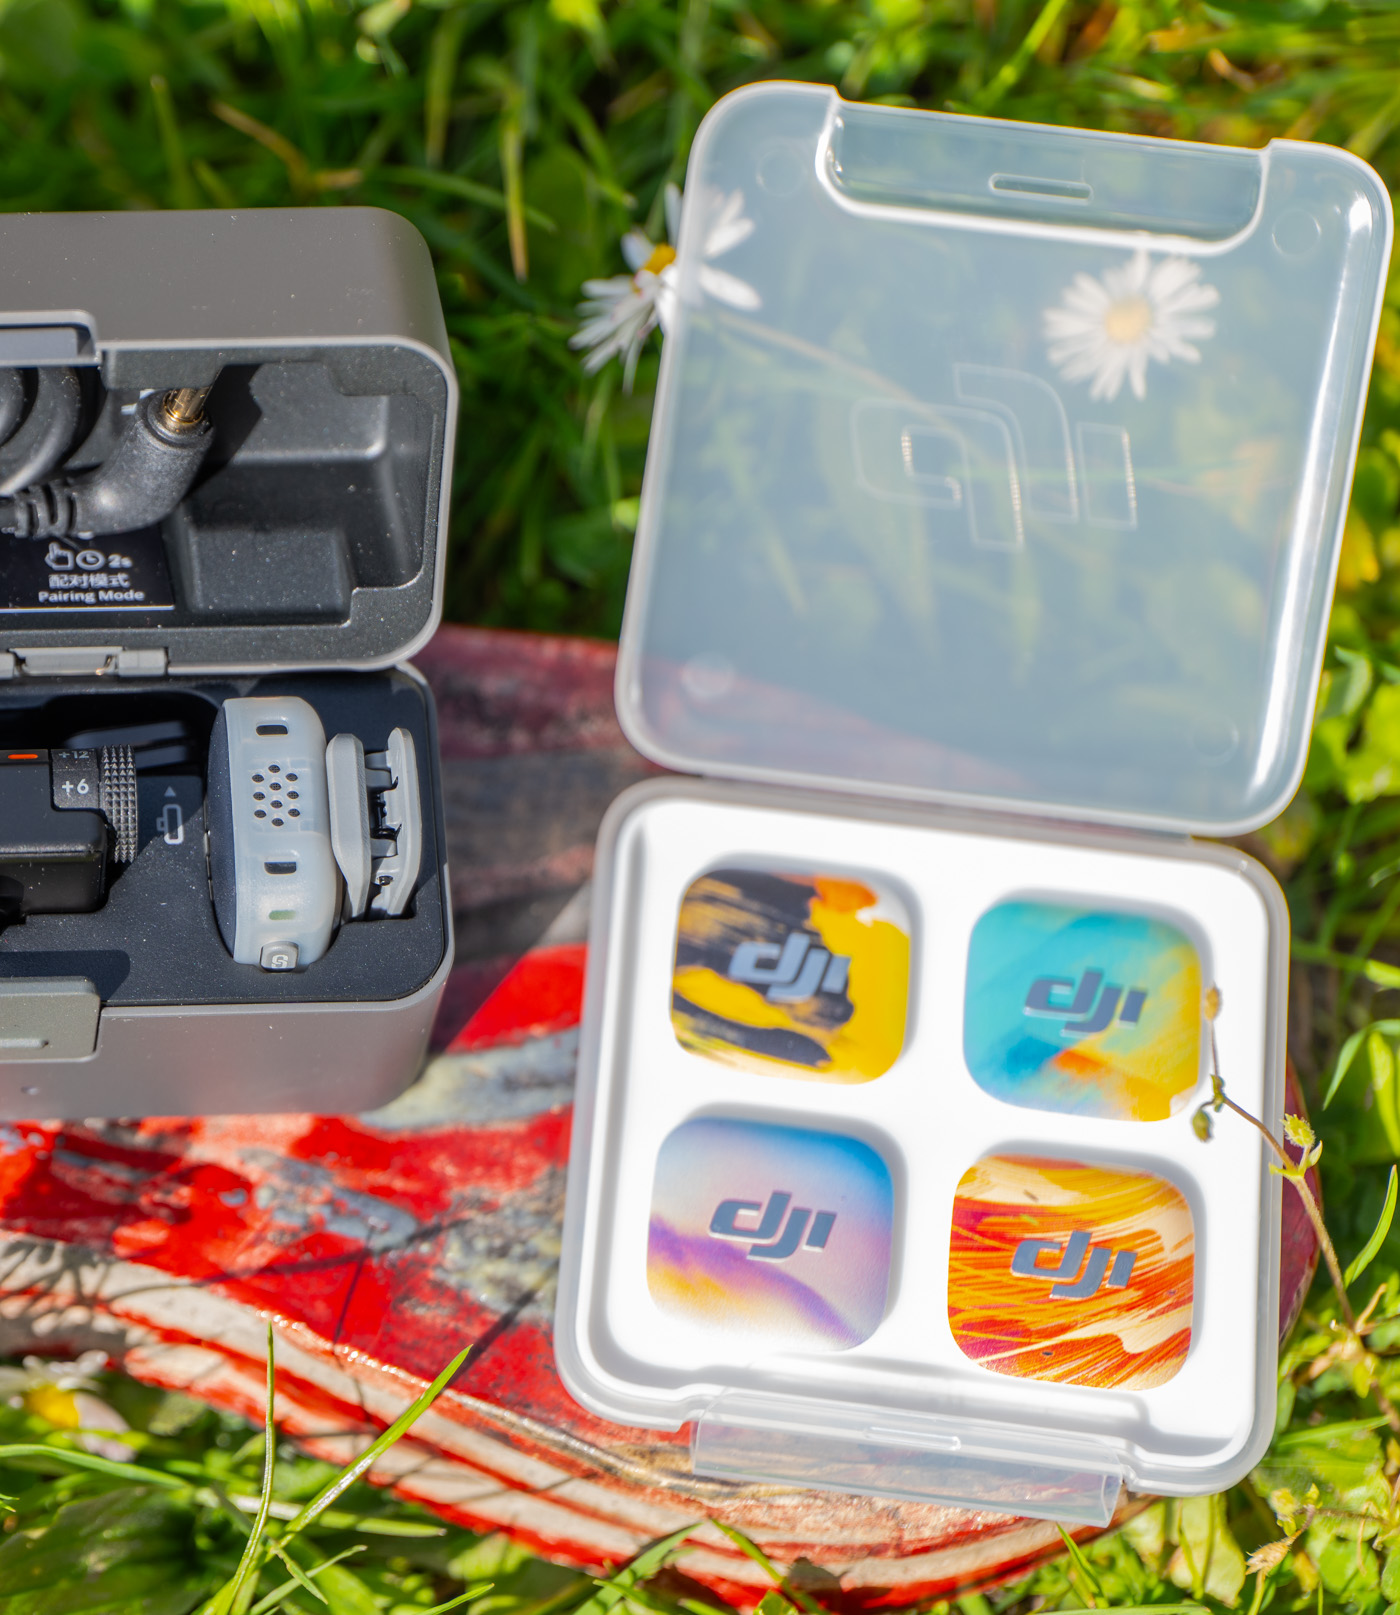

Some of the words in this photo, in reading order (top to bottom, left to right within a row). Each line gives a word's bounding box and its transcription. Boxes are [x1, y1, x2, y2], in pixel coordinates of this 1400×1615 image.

[108, 554, 133, 569] 2s
[48, 572, 131, 589] 配对模式
[38, 590, 96, 605] Pairing
[98, 588, 146, 602] Mode
[61, 778, 89, 795] +6
